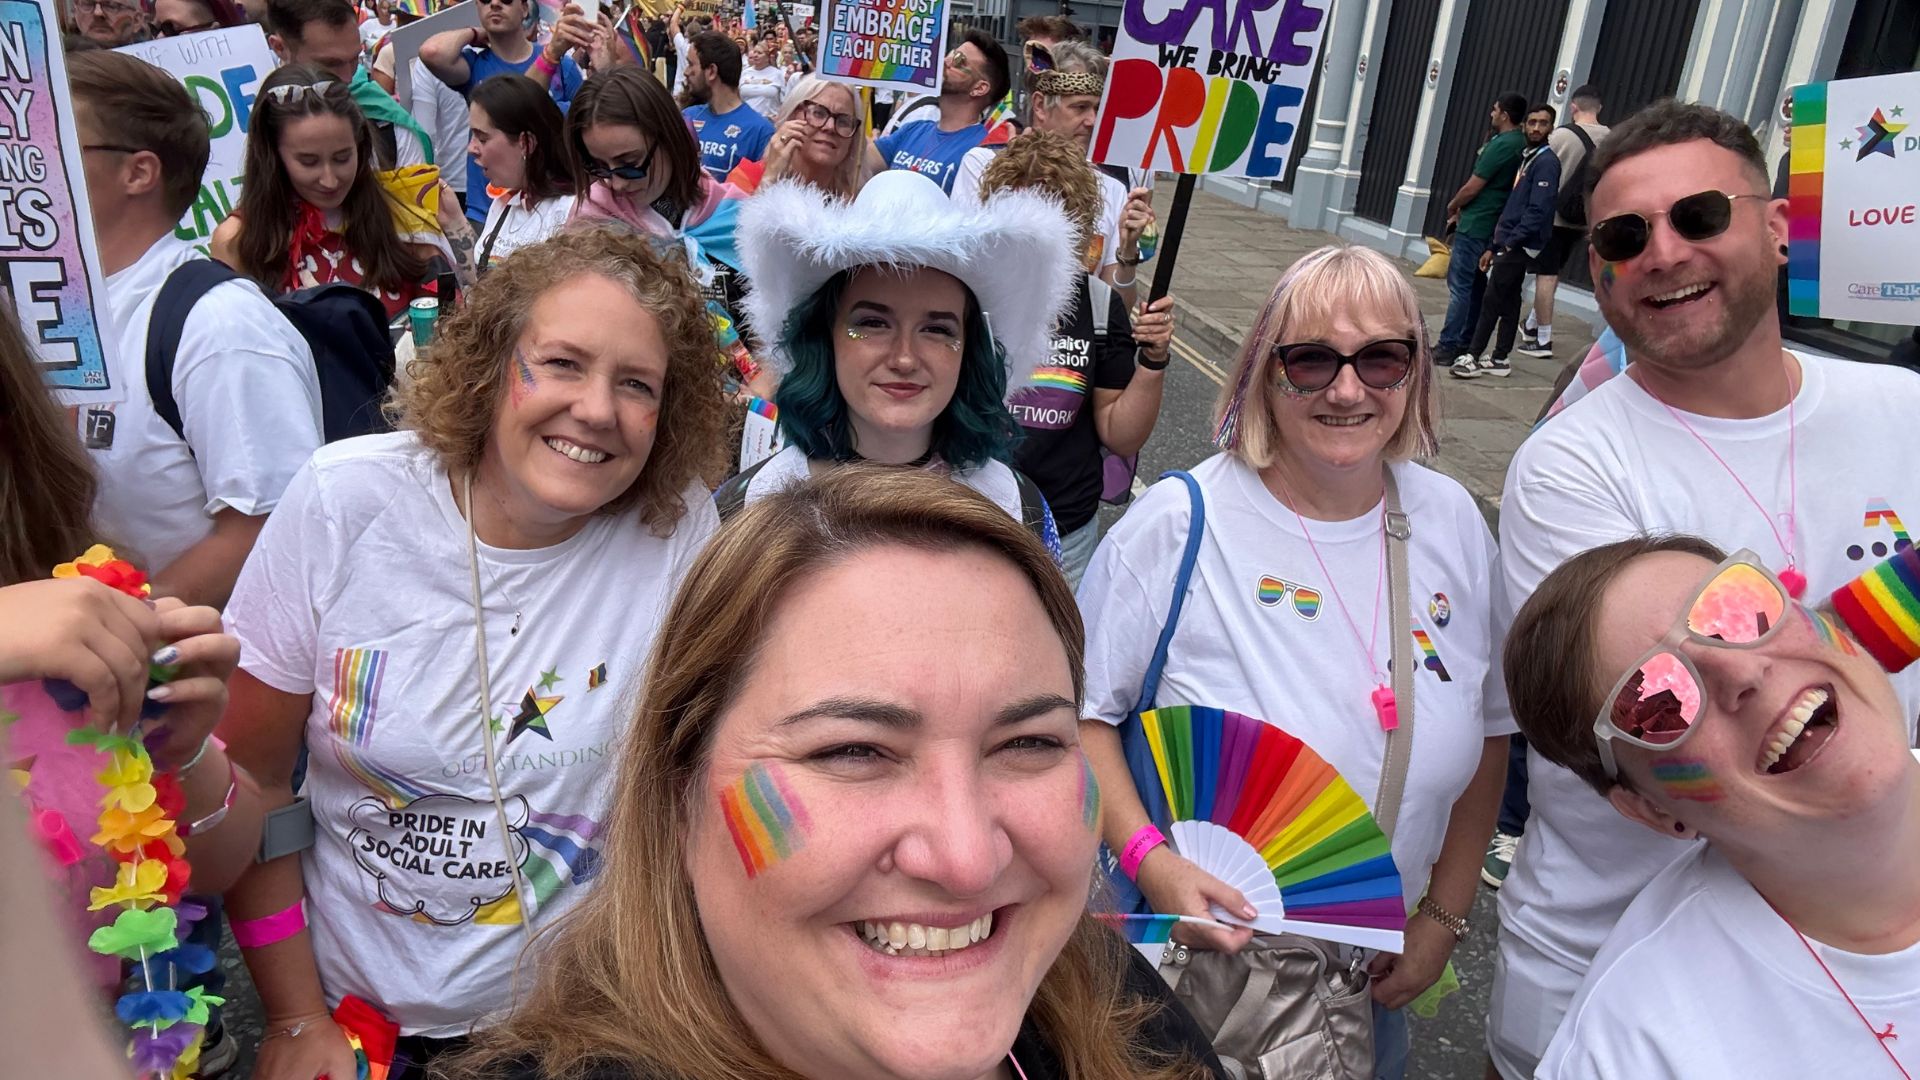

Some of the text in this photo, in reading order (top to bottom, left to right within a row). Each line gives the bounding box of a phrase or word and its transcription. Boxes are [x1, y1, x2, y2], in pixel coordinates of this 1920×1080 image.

[833, 3, 935, 44] EMBRACE
[177, 34, 232, 65] WITH
[831, 35, 932, 69] EACH OTHER
[1158, 43, 1281, 84] WE BRING
[1092, 58, 1304, 177] PRIDE
[893, 151, 943, 175] LEADERS
[1849, 206, 1915, 226] LOVE
[1009, 405, 1075, 425] ETWORK
[389, 812, 486, 839] PRIDE IN
[360, 835, 506, 880] SOCIAL CARE
[400, 831, 472, 859] ADULT
